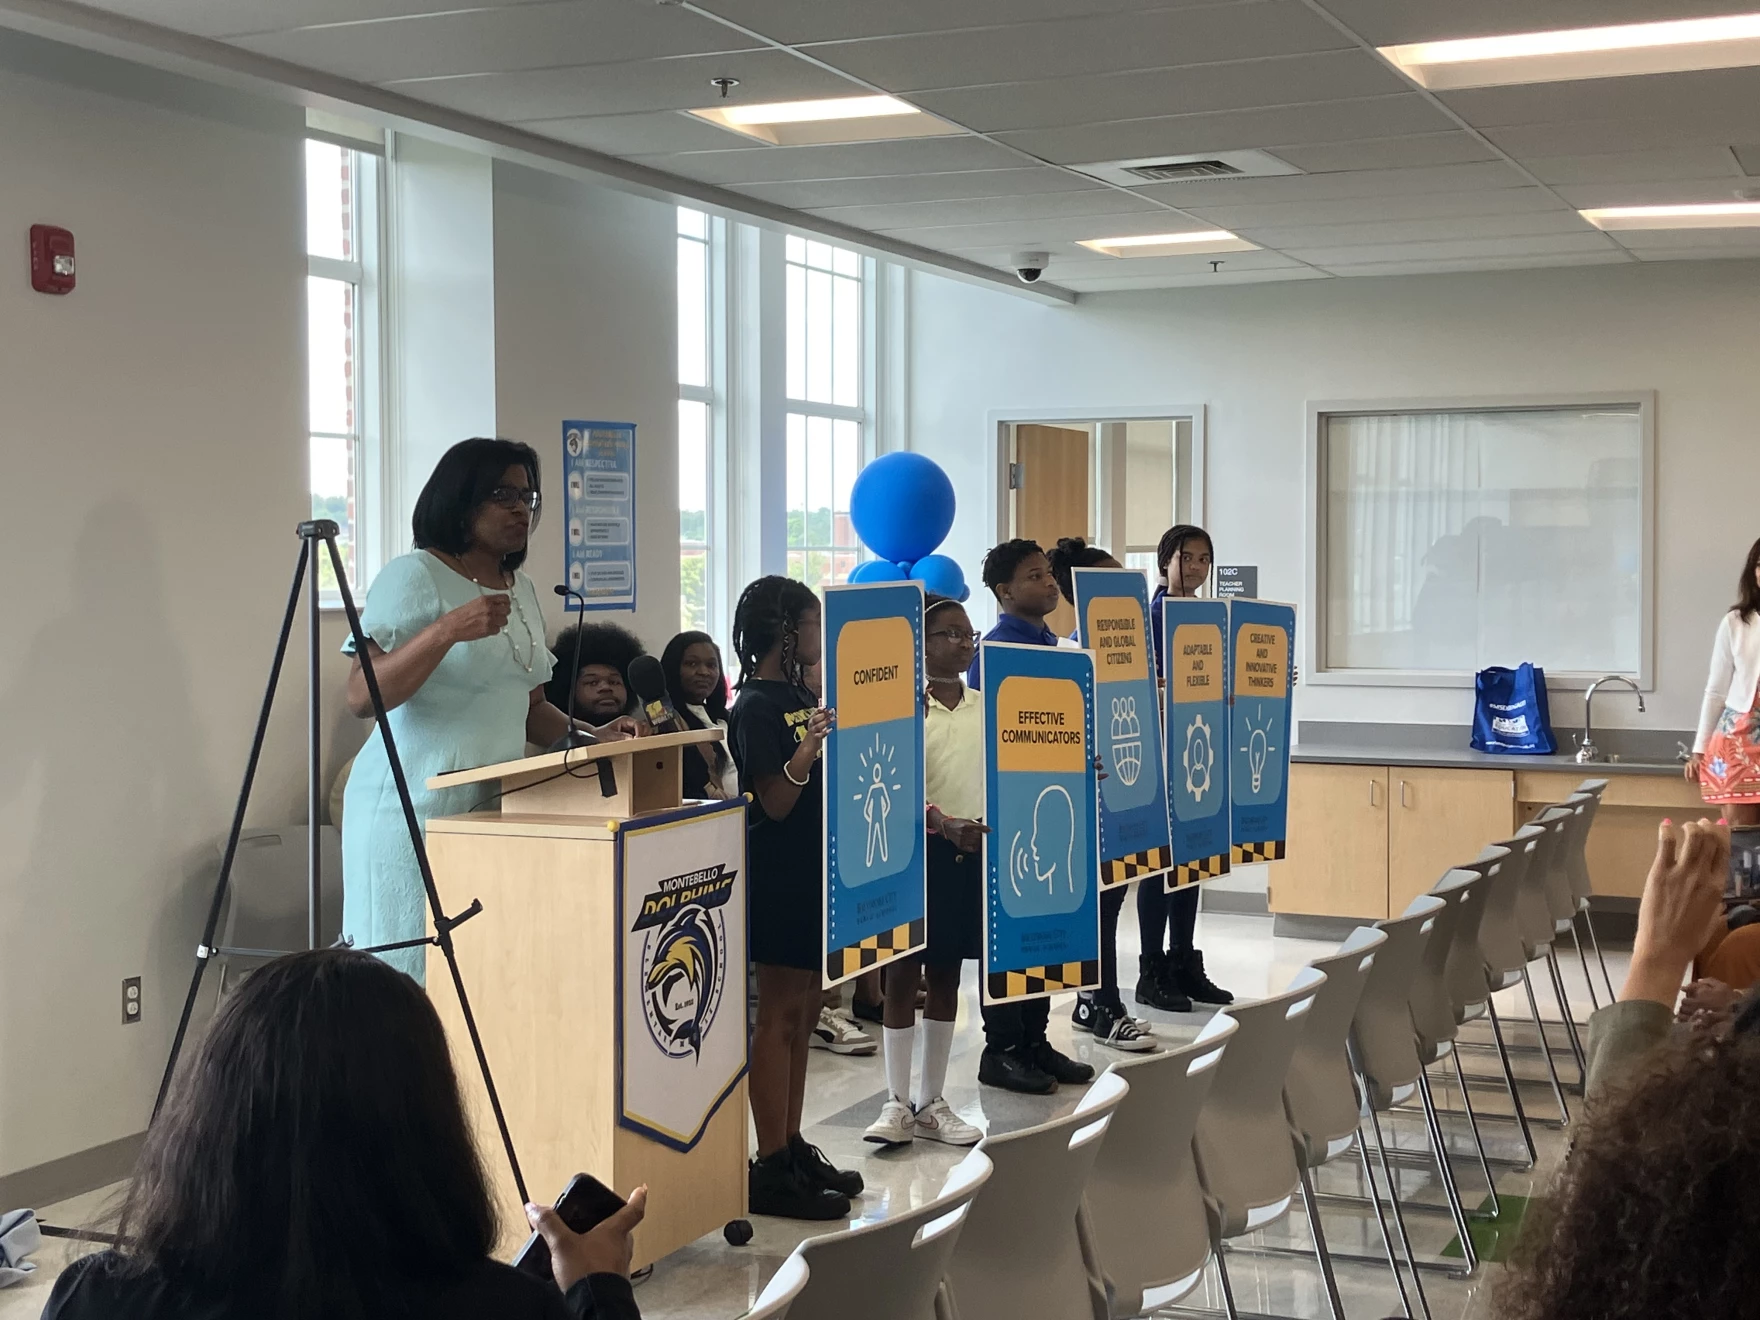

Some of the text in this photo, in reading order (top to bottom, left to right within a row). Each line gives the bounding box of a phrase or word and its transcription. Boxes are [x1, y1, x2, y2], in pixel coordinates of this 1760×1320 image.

[1219, 568, 1238, 576] 102C
[1096, 618, 1136, 631] RESPONSIBLE
[1100, 635, 1136, 648] AND GLOBAL
[1250, 633, 1276, 645] CREATIVE
[1183, 644, 1213, 656] ADAPTABLE
[1256, 648, 1268, 659] AND
[1106, 652, 1132, 665] CITIZENS
[1192, 659, 1204, 671] AND
[1245, 661, 1277, 674] INNOVATIVE
[853, 665, 899, 686] CONFIDENT
[1186, 675, 1210, 687] FLEXIBLE
[1248, 676, 1274, 688] THINKERS
[1018, 710, 1065, 726] EFFECTIVE
[1001, 729, 1081, 745] COMMUNICATORS
[663, 868, 719, 893] MONTEBELLO
